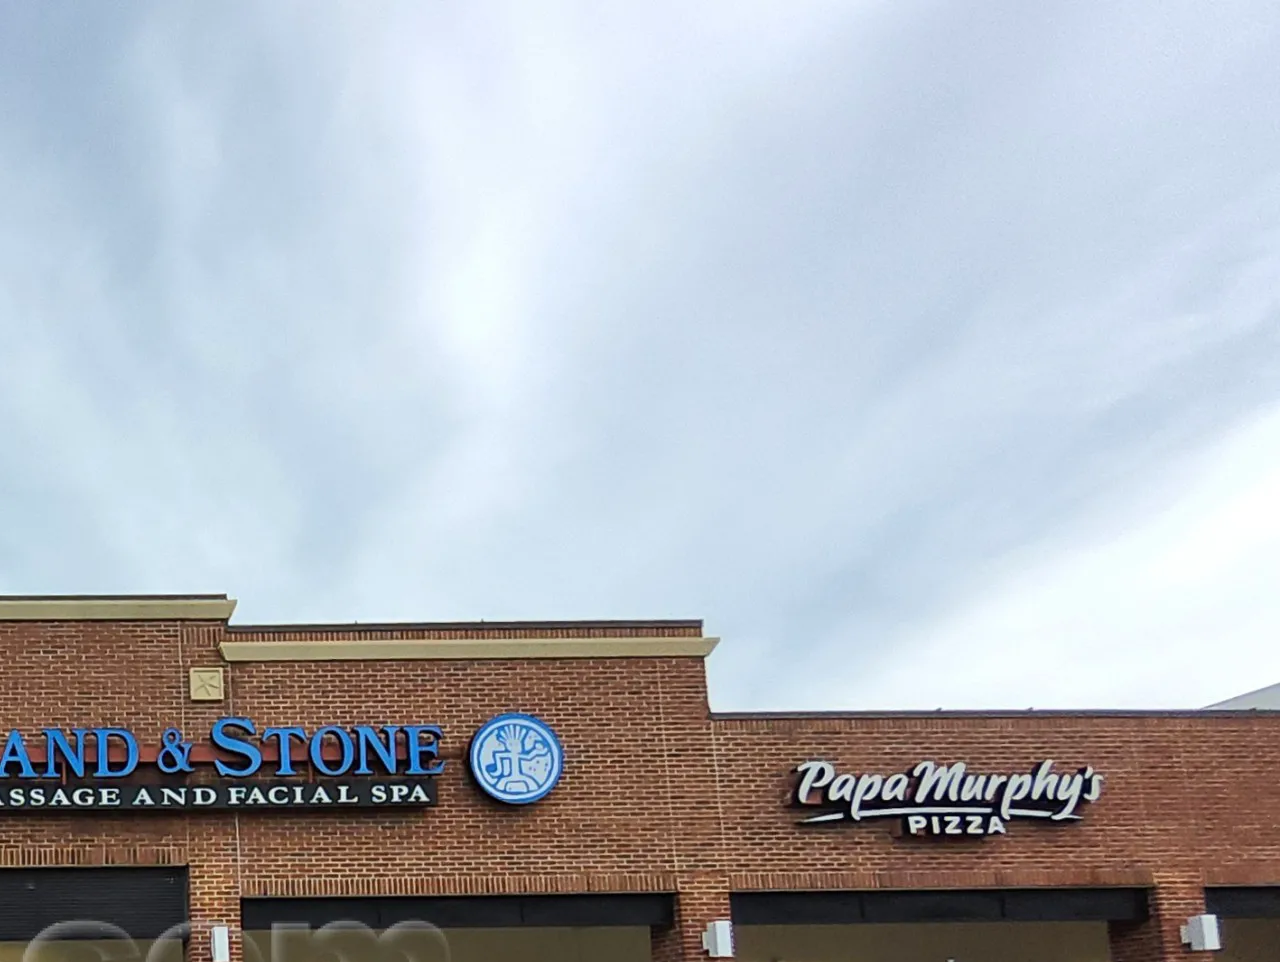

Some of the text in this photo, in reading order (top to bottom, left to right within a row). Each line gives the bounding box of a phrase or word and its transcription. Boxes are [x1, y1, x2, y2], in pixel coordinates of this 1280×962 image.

[157, 728, 196, 774] &
[210, 716, 446, 777] STONE
[132, 786, 219, 806] AND
[227, 784, 359, 805] FACIAL
[371, 783, 430, 804] SPA
[796, 758, 1104, 821] Papa Murphy's
[908, 815, 1006, 835] PIZZA
